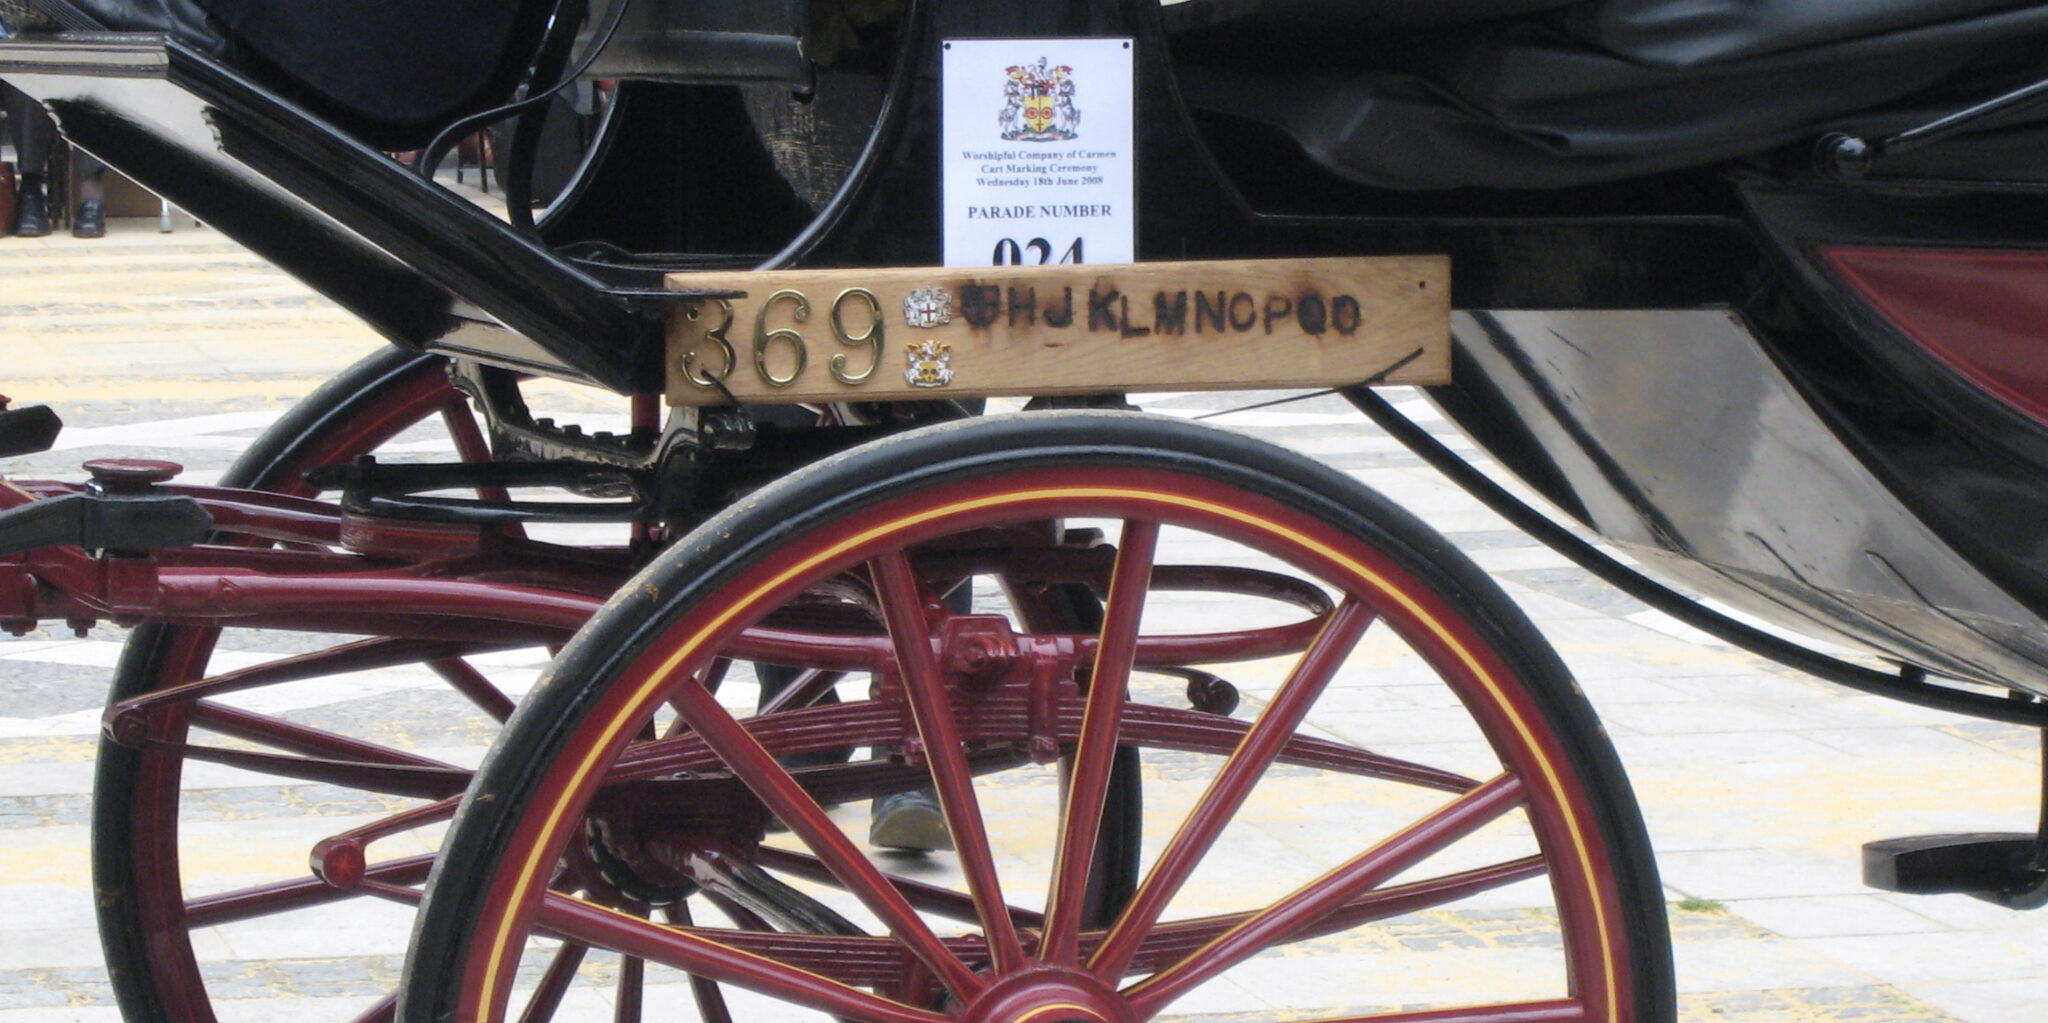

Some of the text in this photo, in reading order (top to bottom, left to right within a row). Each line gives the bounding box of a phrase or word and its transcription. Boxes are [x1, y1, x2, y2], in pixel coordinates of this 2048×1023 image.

[962, 150, 1117, 162] Worshipful Company of Carmen
[981, 163, 1097, 174] Cart Marking Ceremony
[976, 176, 1103, 188] Wednesday 18th June 2008
[967, 204, 1112, 219] PARADE NUMBER
[682, 286, 884, 388] 369
